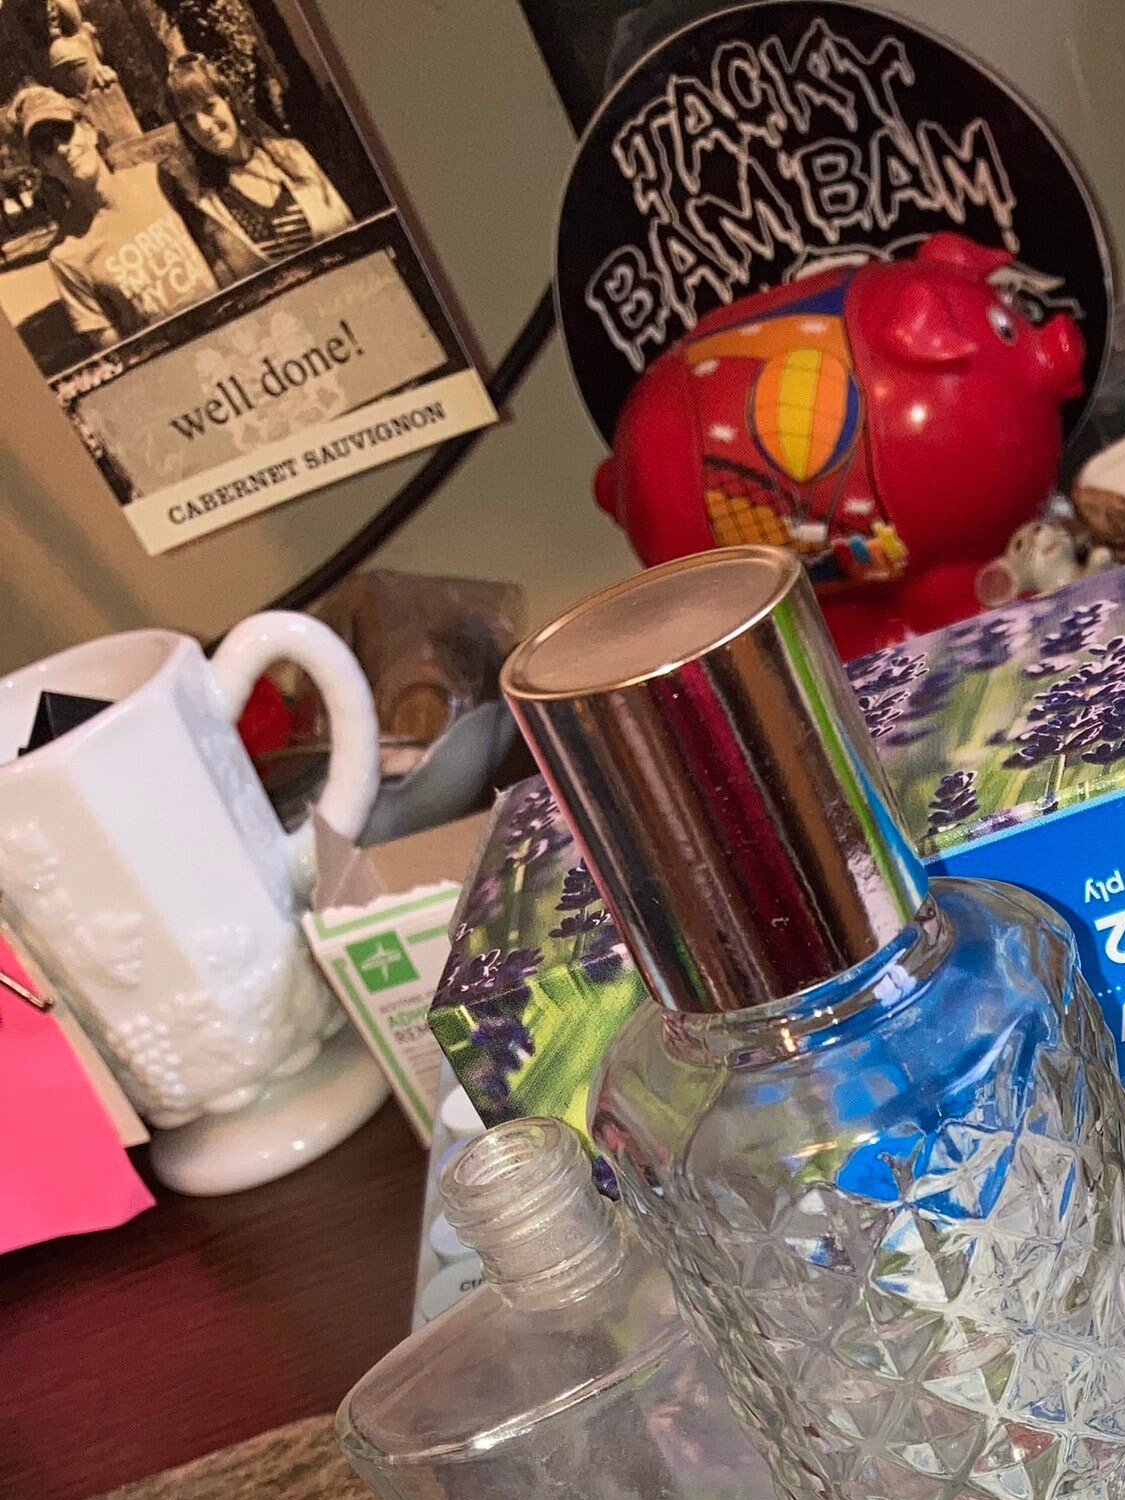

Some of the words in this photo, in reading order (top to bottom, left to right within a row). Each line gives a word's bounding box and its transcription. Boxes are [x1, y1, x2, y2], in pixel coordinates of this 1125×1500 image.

[612, 17, 916, 223] TACKY
[585, 155, 804, 372] BAM
[778, 117, 1019, 253] BAM
[169, 375, 255, 441] well
[260, 319, 365, 398] done!
[167, 457, 299, 526] CABERNET
[302, 401, 447, 471] SAUVIGNON
[1084, 868, 1125, 904] ply
